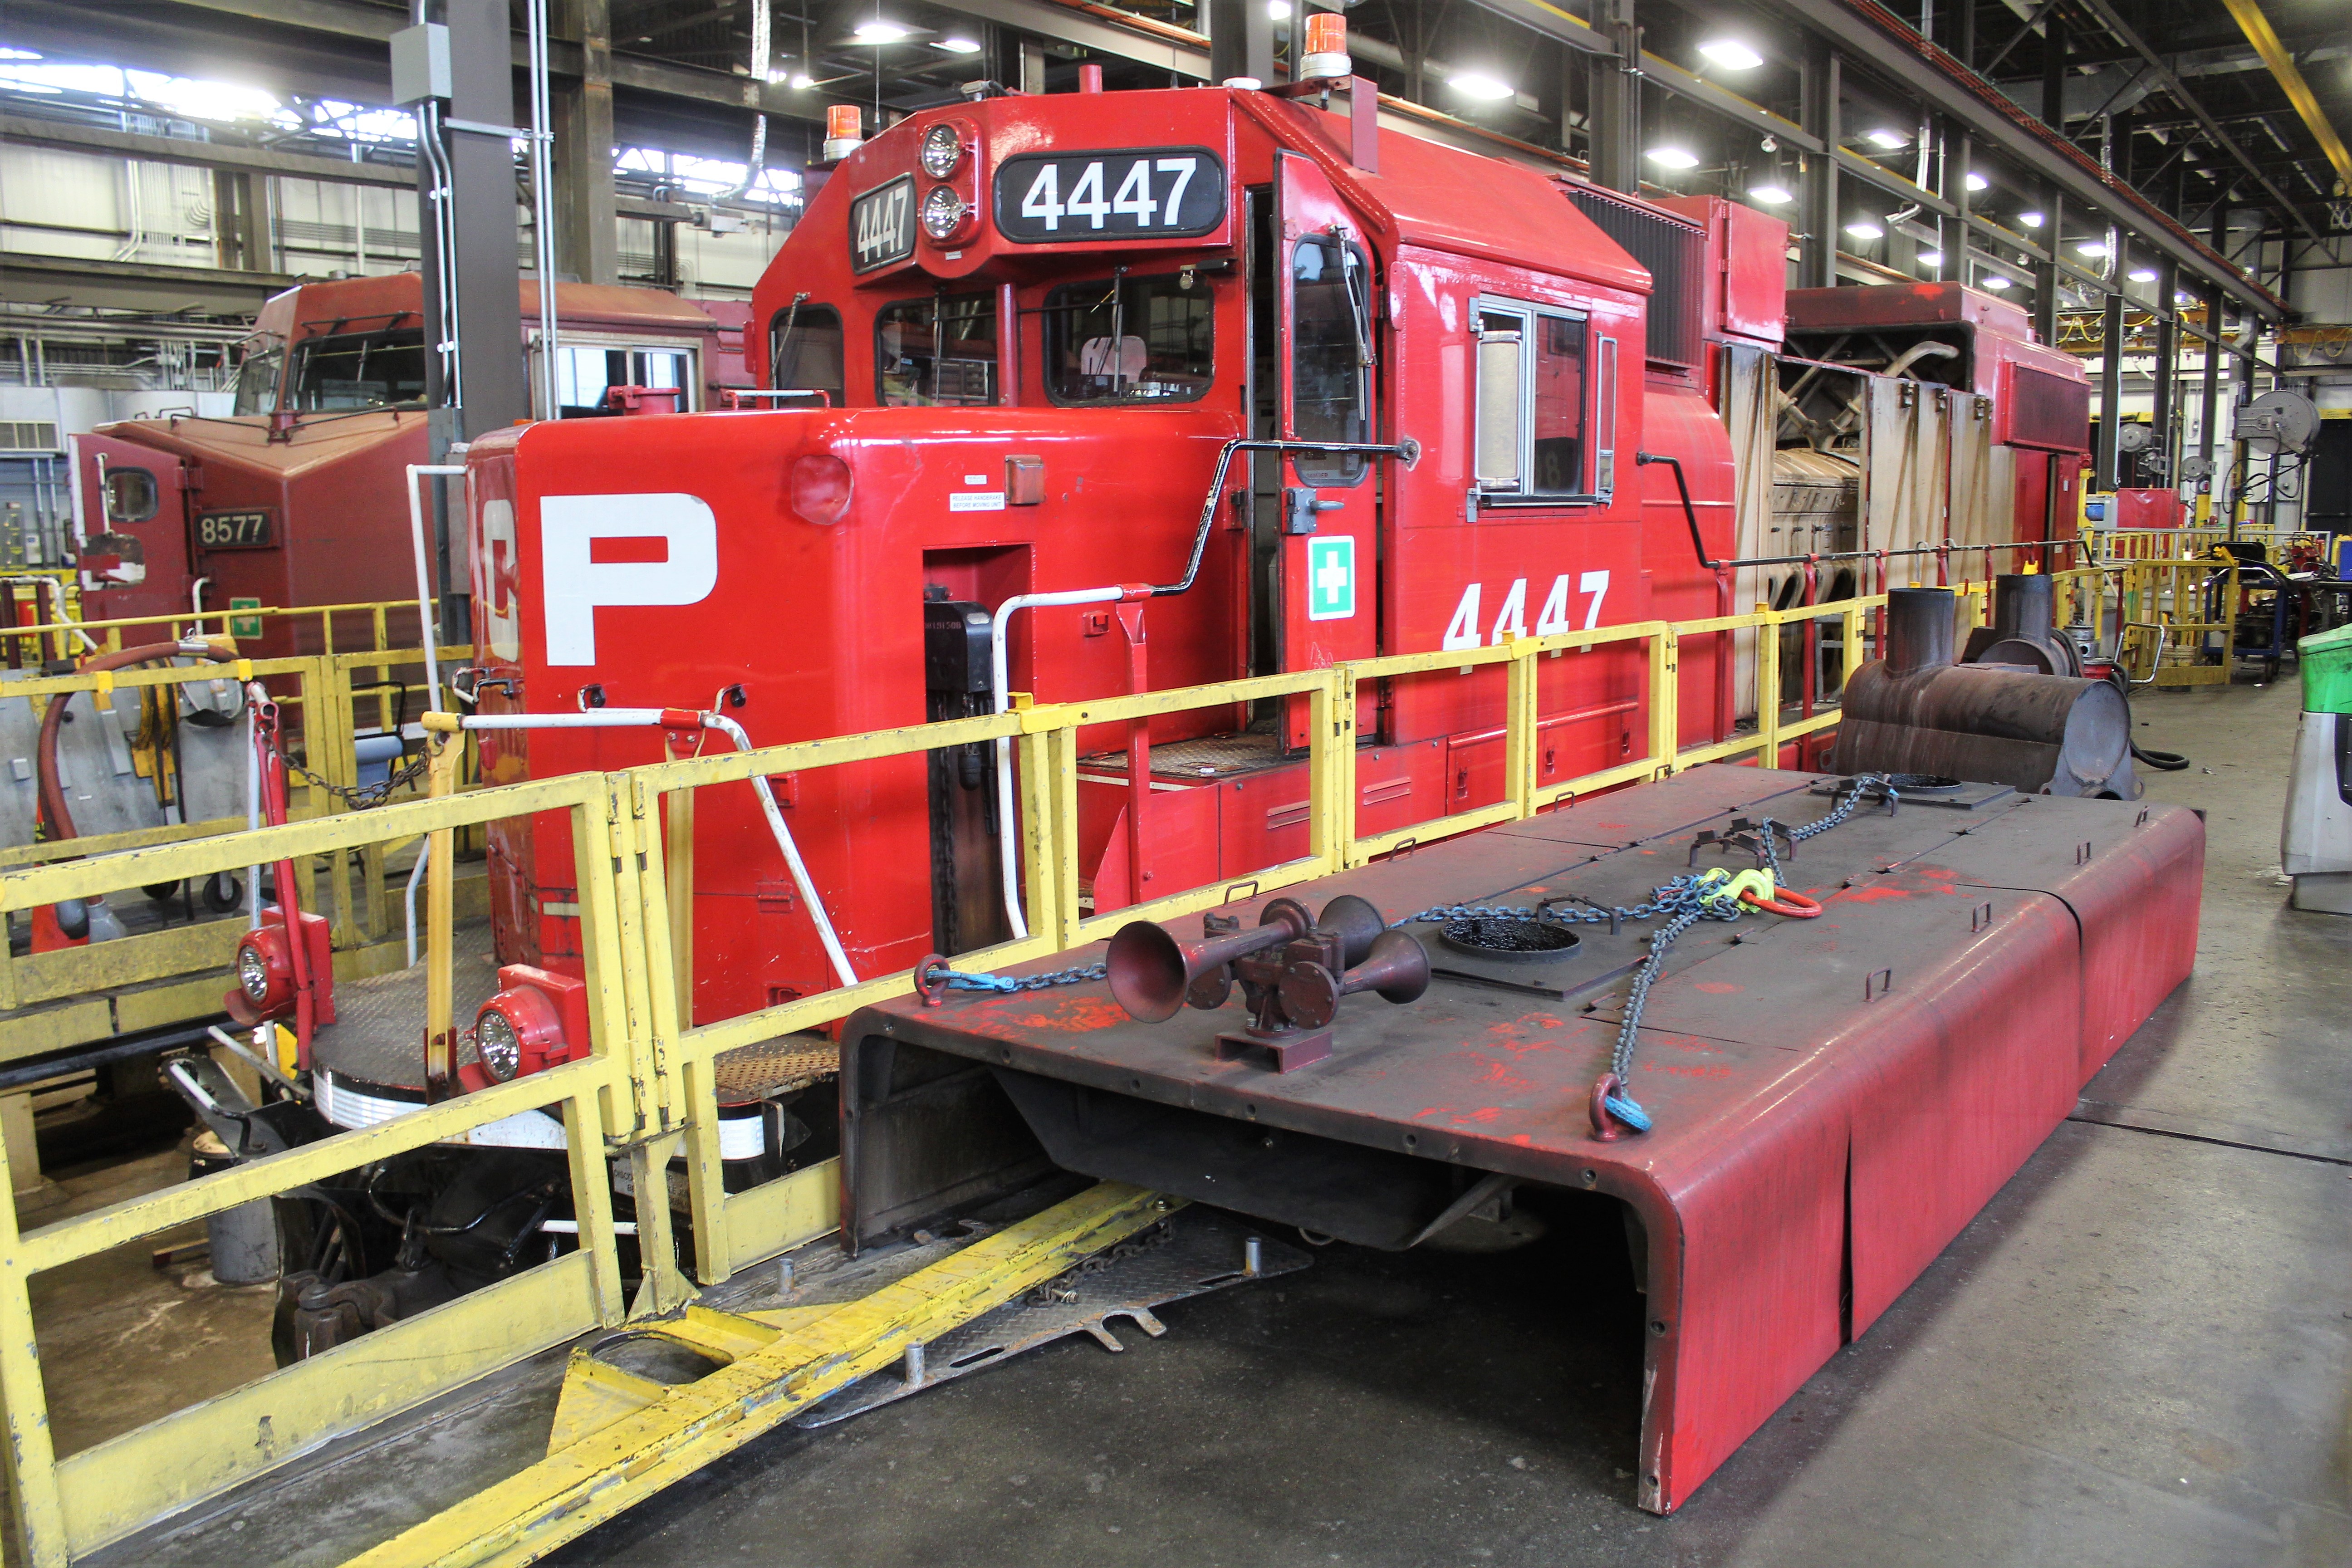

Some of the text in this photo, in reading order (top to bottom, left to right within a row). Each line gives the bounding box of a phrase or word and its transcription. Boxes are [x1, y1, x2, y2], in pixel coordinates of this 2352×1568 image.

[858, 185, 908, 263] 4447
[1021, 157, 1197, 231] 4447
[201, 514, 263, 544] 8577
[1443, 570, 1610, 675] 4447
